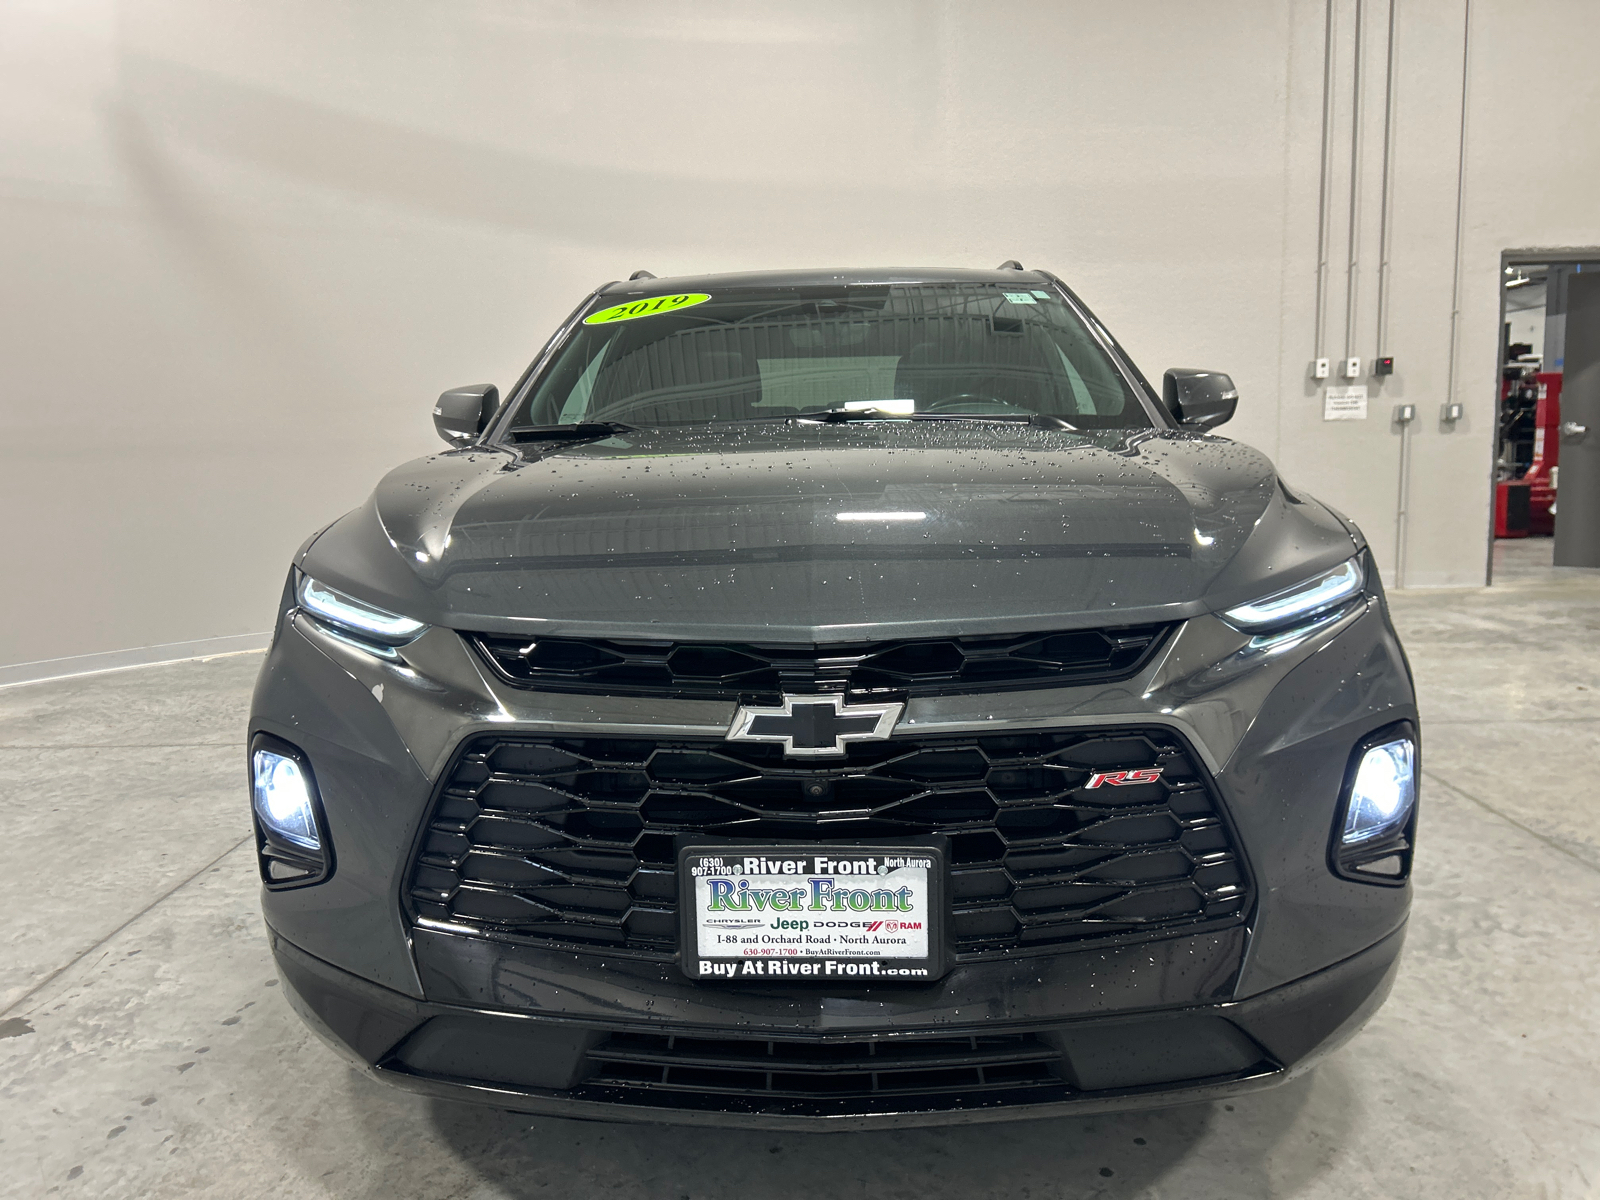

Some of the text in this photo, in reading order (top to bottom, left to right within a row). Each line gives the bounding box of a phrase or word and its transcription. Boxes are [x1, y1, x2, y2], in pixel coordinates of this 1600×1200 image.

[606, 295, 690, 320] 2019
[1084, 767, 1164, 789] RS
[700, 858, 723, 867] (630)
[743, 857, 877, 874] River Front
[884, 857, 931, 868] North Aurora
[691, 866, 731, 876] 907-1700
[707, 878, 914, 912] River Front
[770, 917, 809, 931] Jeep
[717, 934, 907, 944] I-88 and Orchard Road North Aurora
[805, 948, 881, 956] BuyAtRiverFront.com
[699, 960, 928, 977] Buy At River Front.com
